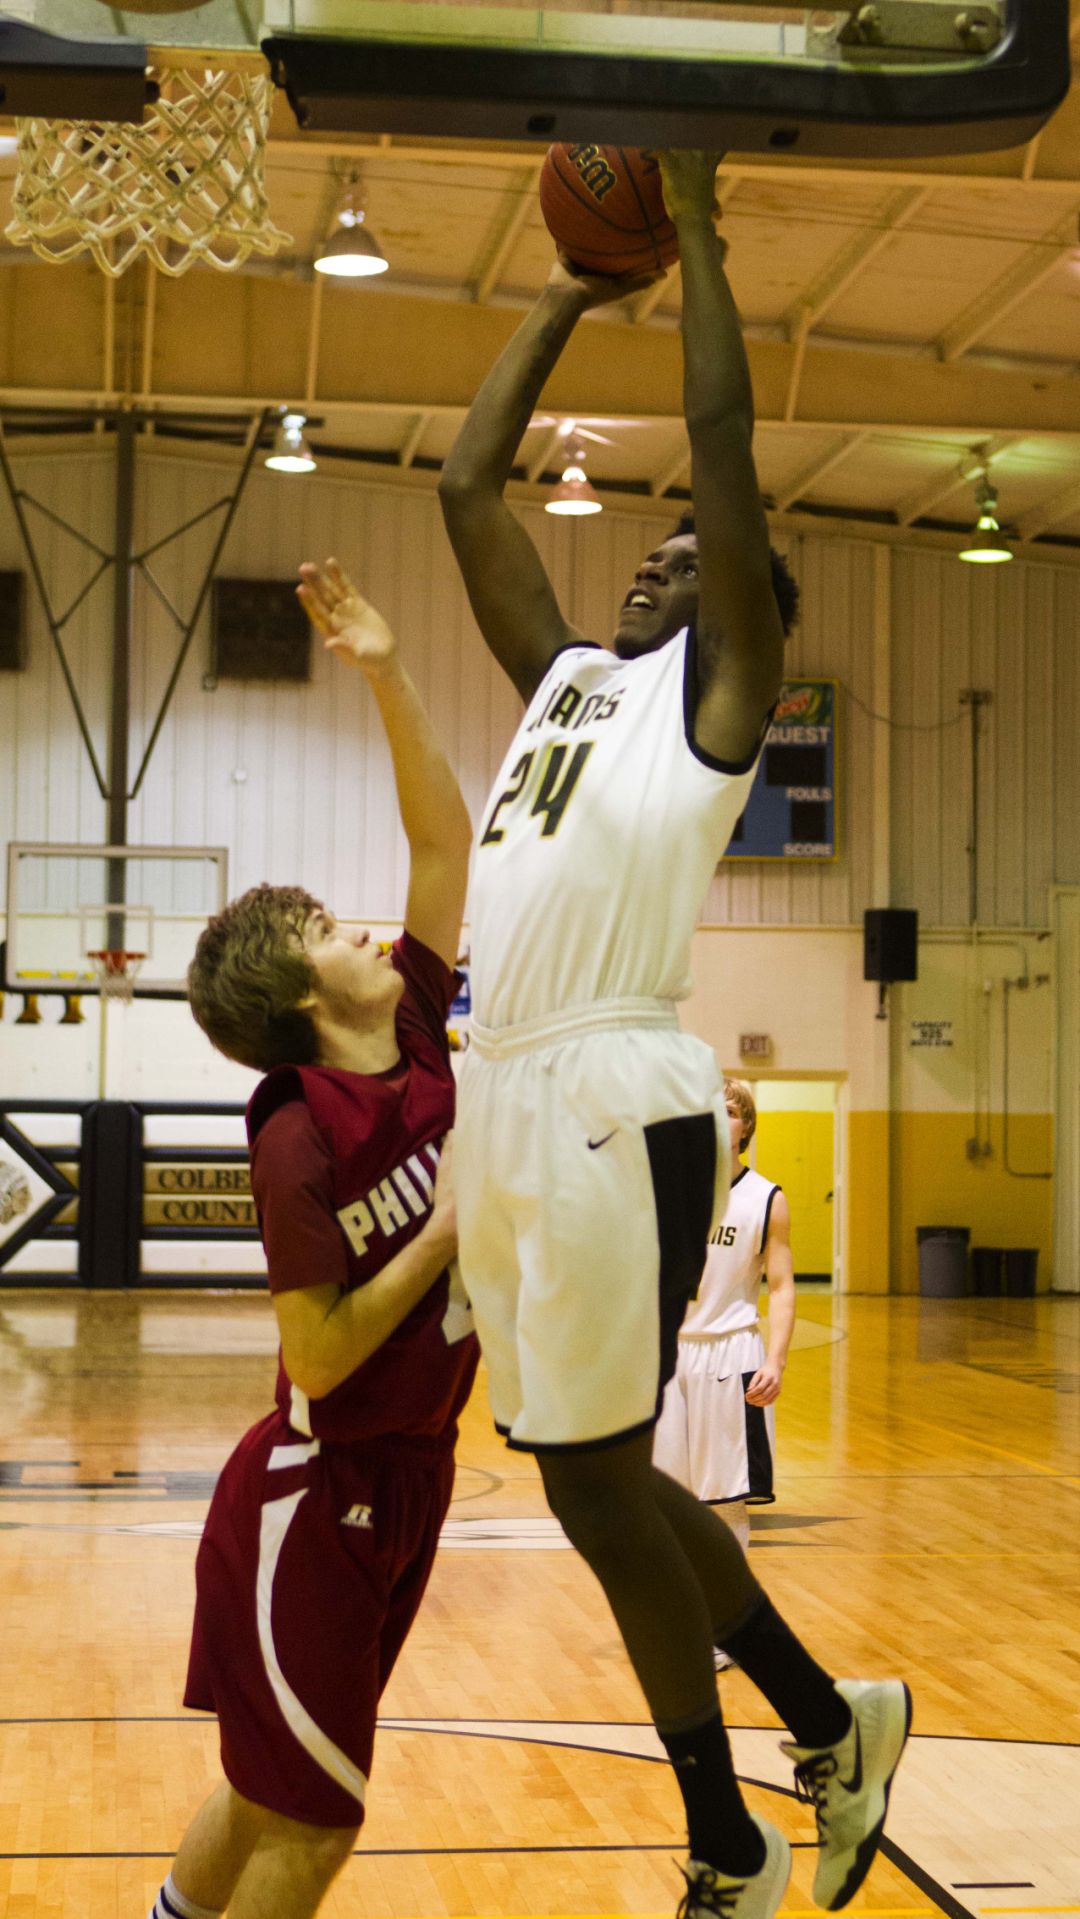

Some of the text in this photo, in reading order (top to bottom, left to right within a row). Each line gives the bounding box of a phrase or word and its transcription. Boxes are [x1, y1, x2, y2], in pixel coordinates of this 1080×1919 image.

[527, 681, 626, 733] IANS
[766, 726, 830, 744] GUEST
[480, 741, 595, 846] 24
[786, 787, 832, 800] FOULS
[784, 843, 832, 856] SCORE
[158, 1168, 249, 1190] COLBE
